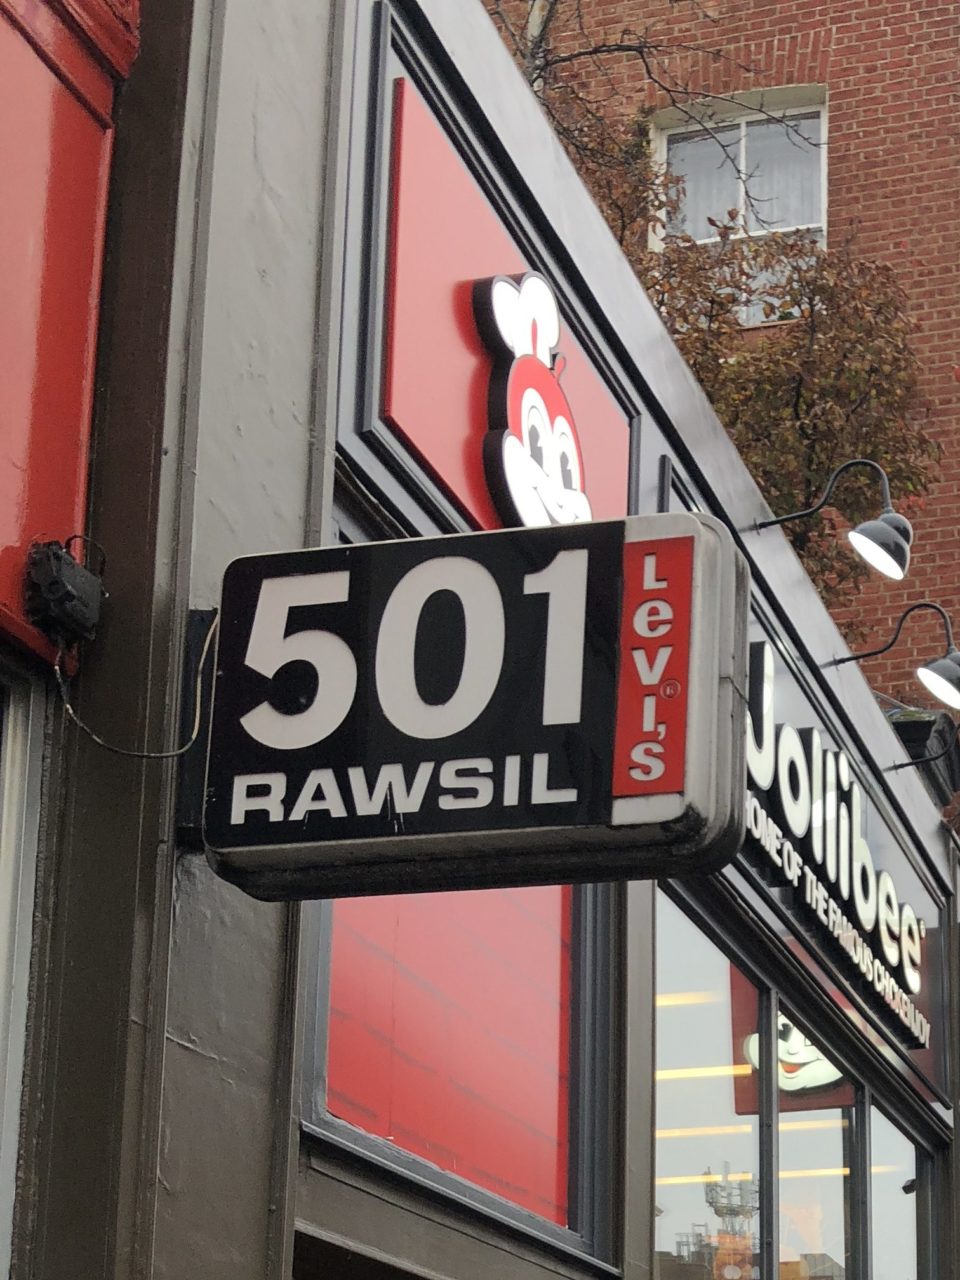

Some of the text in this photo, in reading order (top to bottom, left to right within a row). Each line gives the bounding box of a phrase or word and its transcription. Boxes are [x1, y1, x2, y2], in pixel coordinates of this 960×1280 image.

[238, 548, 590, 751] 501
[230, 753, 578, 826] RAWSIL
[746, 641, 922, 994] Jollibee
[781, 840, 804, 888] OF
[803, 865, 829, 925] THE
[828, 897, 874, 982] FAMOUS
